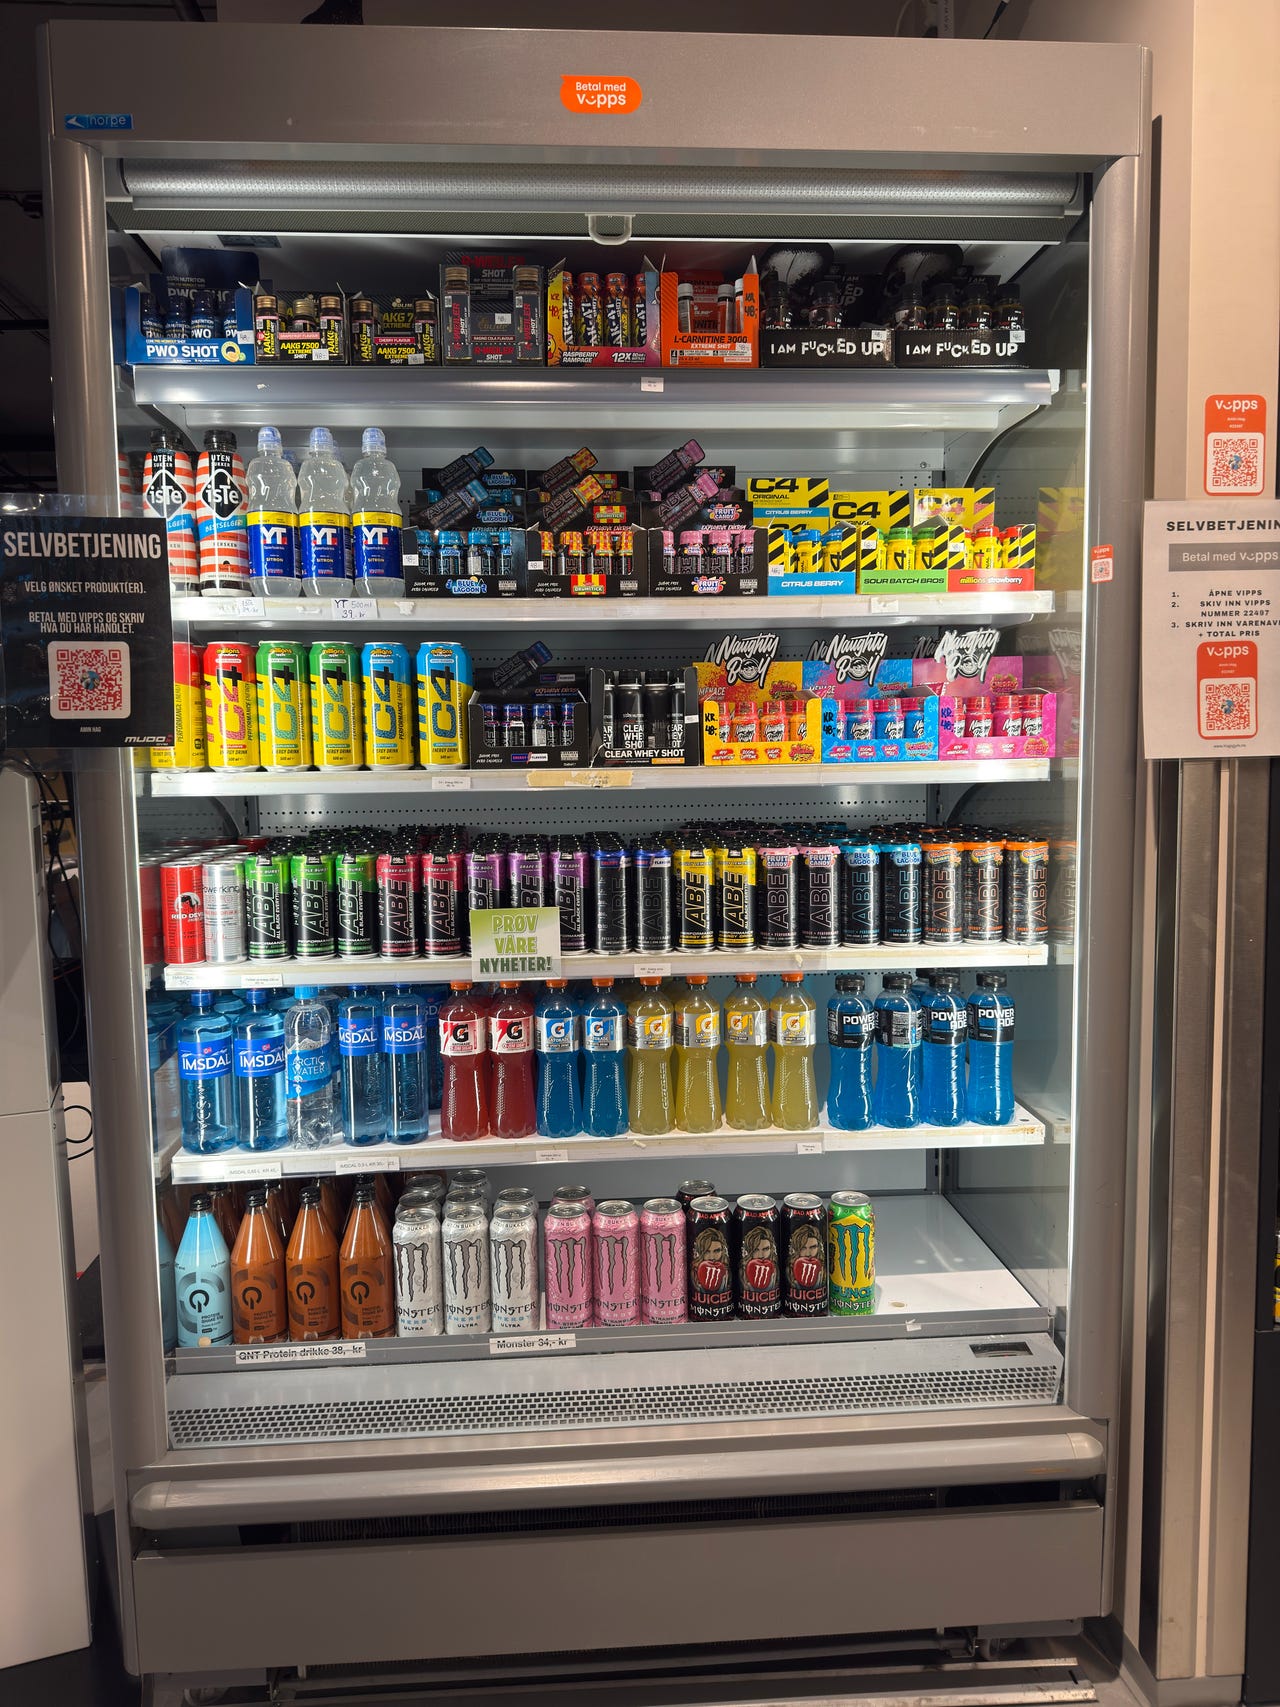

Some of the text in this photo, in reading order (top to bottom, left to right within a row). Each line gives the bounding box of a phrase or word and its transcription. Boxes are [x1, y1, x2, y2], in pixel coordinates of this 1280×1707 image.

[575, 82, 626, 92] Betal med
[674, 335, 725, 343] L-CARNITINE
[146, 345, 219, 358] PWO SHOT
[770, 338, 885, 357] I AM FUCKED UP
[905, 339, 1019, 358] I AM FUCKED UP
[153, 454, 173, 462] UTEN
[210, 454, 230, 462] UTEN
[750, 478, 799, 493] C4
[832, 502, 881, 519] C4
[1166, 519, 1280, 532] SELVBETJENIN
[261, 527, 287, 545] YT
[311, 528, 337, 545] YT
[362, 527, 388, 545] YT
[4, 531, 162, 559] SELVBETJENING
[1182, 552, 1210, 562] Betal
[1213, 551, 1236, 561] med
[24, 581, 147, 594] VELG ØNSKET PRODUKT(ER).
[959, 576, 1023, 585] millions strawberry
[1208, 589, 1233, 597] ÅPNE
[334, 599, 348, 609] YT
[28, 611, 145, 624] BETAL MED VIPPS OG SKRIV
[40, 622, 134, 634] HVA DU HAR HANDLET.
[216, 665, 246, 741] C4
[271, 665, 298, 741] C4
[322, 666, 350, 741] C4
[371, 666, 397, 740] C4
[430, 666, 457, 740] C4
[604, 748, 685, 758] CLEAR WHEY SHOT
[766, 854, 788, 862] FRUIT
[809, 853, 831, 861] FRUIT
[252, 877, 275, 938] ABE
[300, 878, 325, 936] ABE
[338, 877, 359, 935] ABE
[386, 877, 409, 936] ABE
[491, 913, 538, 934] PRØV
[494, 935, 538, 955] VÅRE
[479, 956, 552, 974] NYHETER!
[931, 1009, 967, 1021] POWER
[978, 1007, 1015, 1018] POWER
[842, 1014, 875, 1026] POWER
[950, 1020, 967, 1030] ADE
[997, 1017, 1015, 1027] ADE
[452, 1023, 469, 1042] G
[506, 1021, 523, 1039] G
[550, 1022, 566, 1037] G
[591, 1021, 605, 1037] G
[650, 1019, 663, 1036] G
[339, 1032, 378, 1044] MSDAL
[384, 1029, 425, 1042] IMSDAL
[182, 1054, 232, 1071] IMSDAL
[240, 1052, 285, 1068] IMSDAL
[292, 1055, 326, 1067] ARCTIC
[292, 1065, 325, 1076] WATER
[693, 1290, 732, 1302] JUICED
[740, 1288, 780, 1301] JUICED
[788, 1286, 827, 1300] JUICED
[690, 1302, 735, 1316] MONSTER
[737, 1301, 782, 1315] MONSTER
[785, 1299, 828, 1313] MONSTER
[497, 1340, 535, 1349] Monster
[558, 1337, 568, 1346] kr
[238, 1350, 260, 1361] QNT
[263, 1349, 297, 1360] Protein
[300, 1347, 330, 1357] drikke
[352, 1345, 363, 1354] kr
